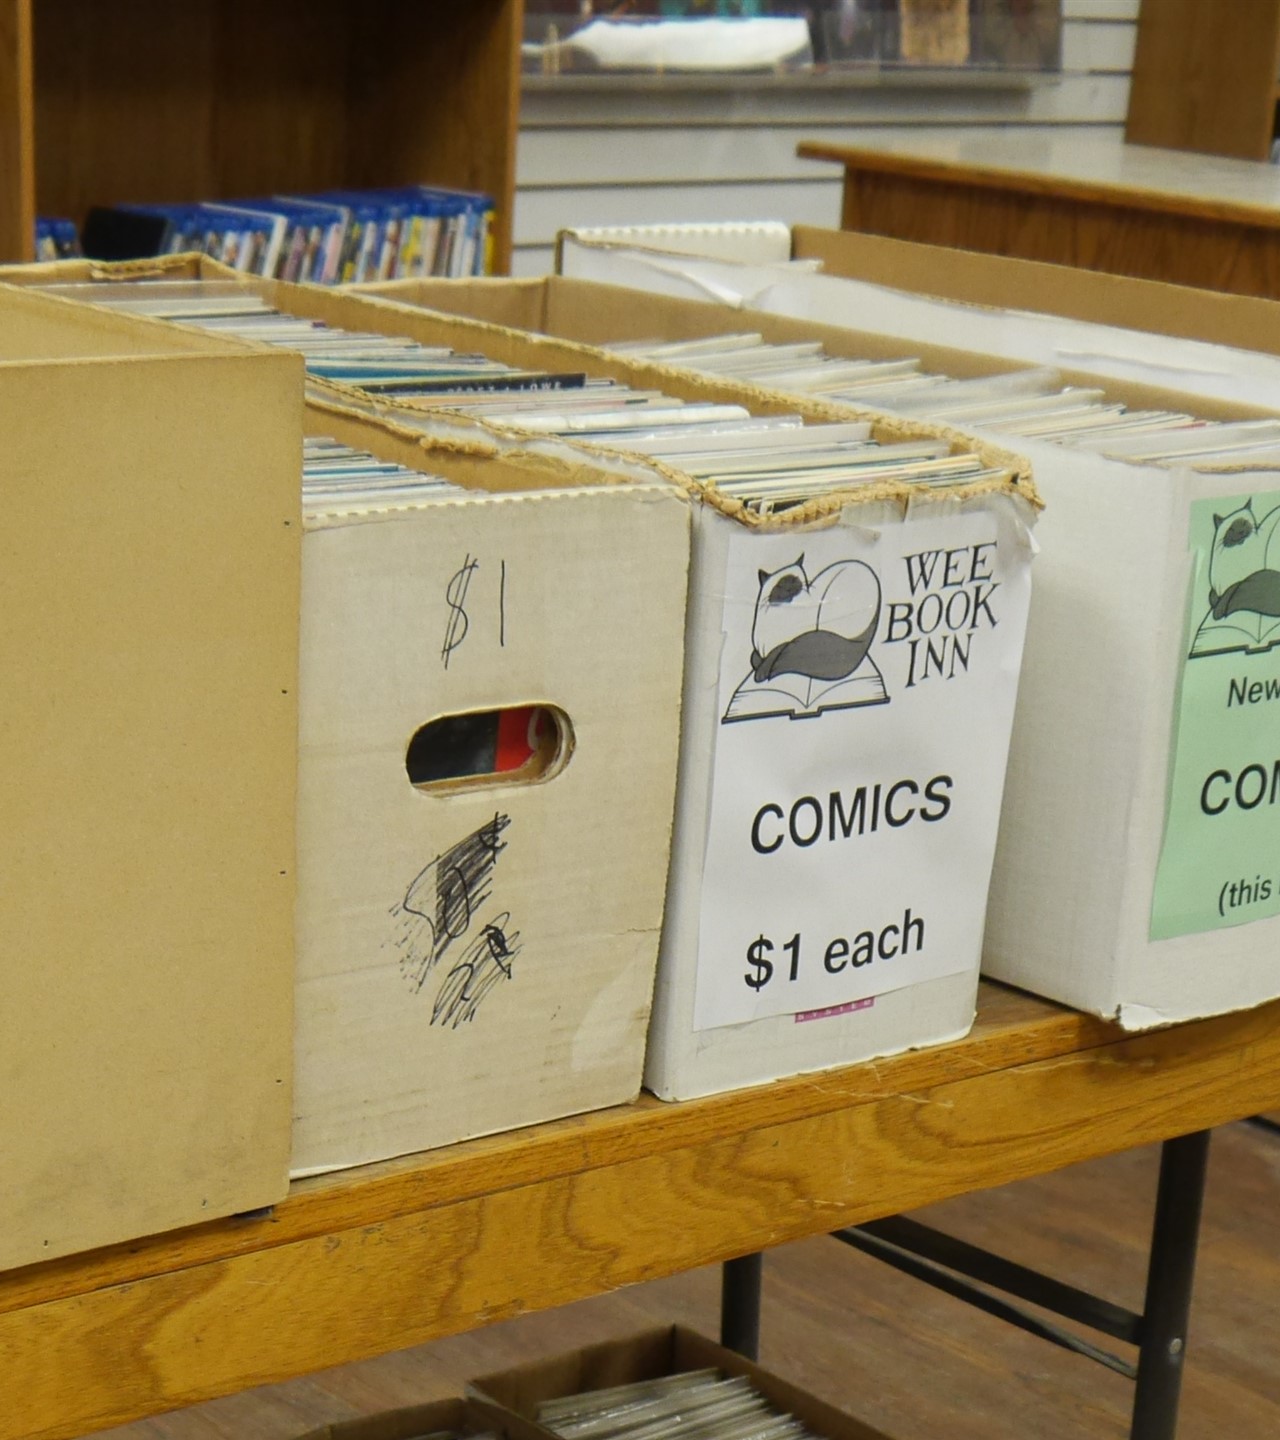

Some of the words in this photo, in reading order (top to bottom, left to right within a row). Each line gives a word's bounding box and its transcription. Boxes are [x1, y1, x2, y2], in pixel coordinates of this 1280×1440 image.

[902, 541, 1000, 597] WEE
[440, 552, 506, 670] $1
[882, 582, 1002, 645] BOOK
[905, 632, 976, 690] INN
[750, 772, 956, 856] COMICS
[1218, 876, 1272, 917] (this
[743, 930, 806, 993] $1
[823, 907, 927, 977] each
